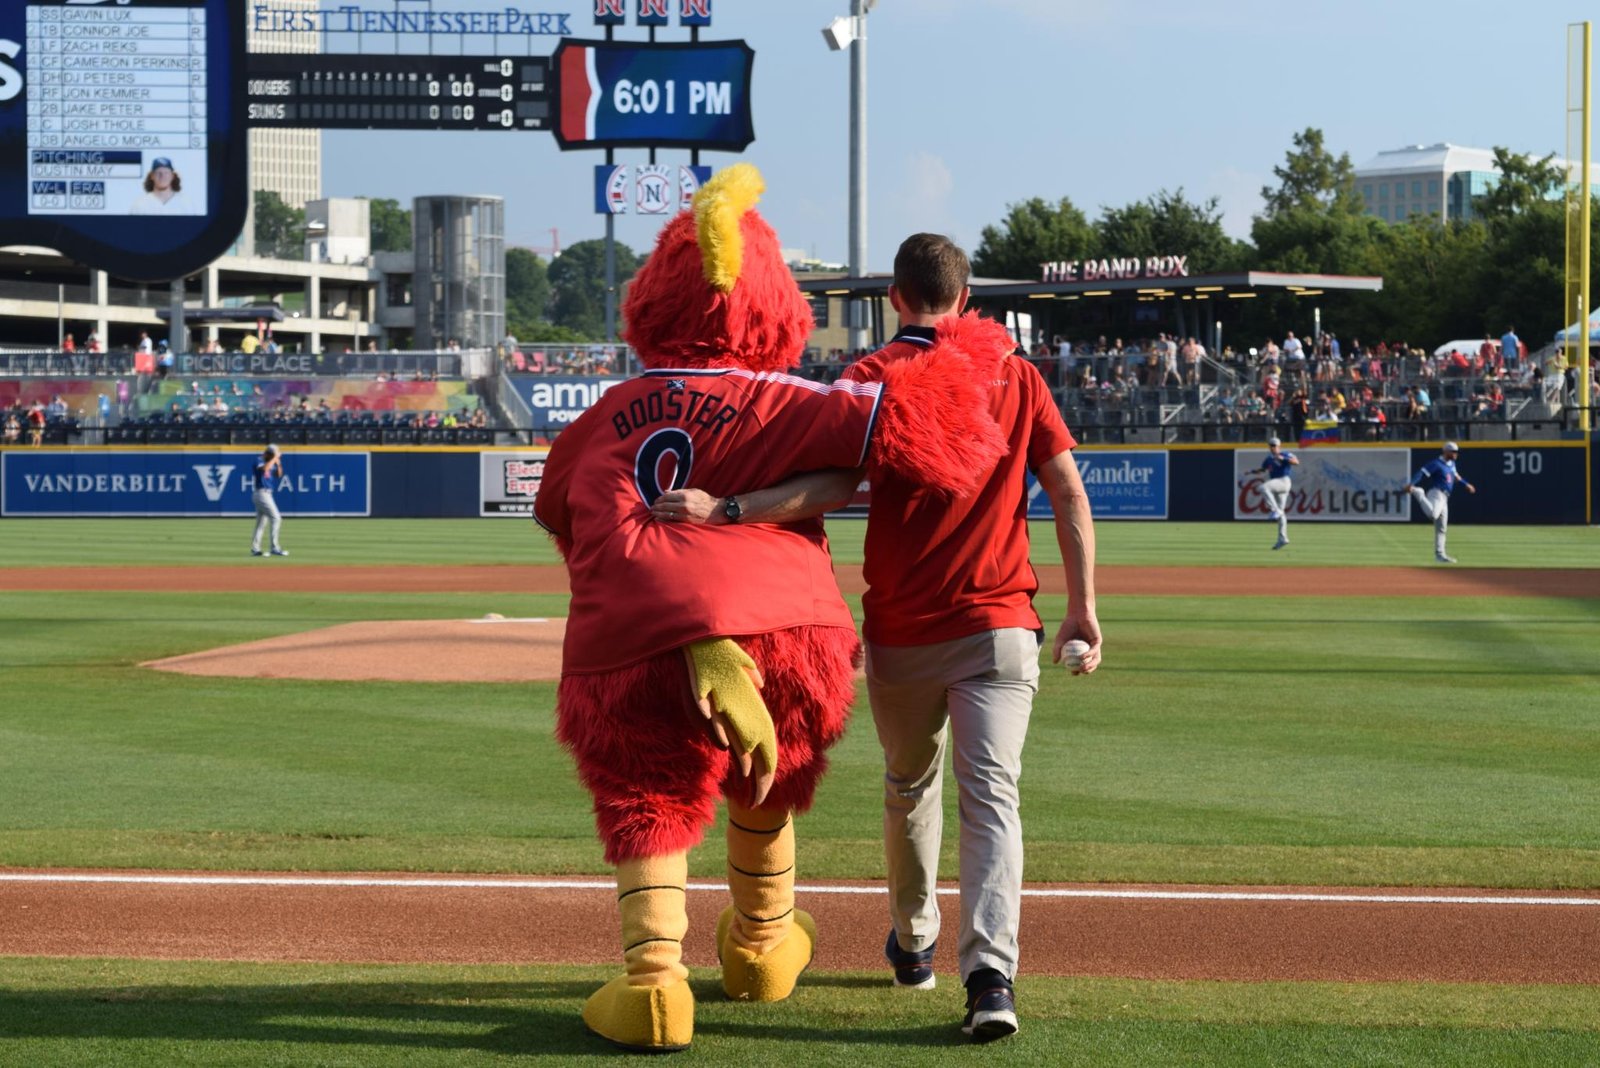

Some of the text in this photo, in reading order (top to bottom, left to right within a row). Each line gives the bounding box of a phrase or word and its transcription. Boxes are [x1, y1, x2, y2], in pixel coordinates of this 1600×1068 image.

[63, 9, 102, 20] GAVIN
[106, 10, 131, 21] LUX
[254, 5, 572, 35] FIRST TENNESSEE PARK
[63, 25, 120, 36] CONNOR
[127, 26, 148, 36] JOE
[63, 41, 99, 51] ZACH
[103, 41, 137, 52] REKS
[41, 56, 59, 67] CF
[63, 57, 128, 68] CAMERON
[133, 57, 187, 69] PERKINS
[501, 59, 513, 77] 0
[63, 72, 79, 83] DJ
[84, 73, 135, 84] PETERS
[63, 88, 90, 98] JON
[94, 89, 150, 99] KEMMER
[429, 81, 440, 97] 0
[451, 81, 462, 97] 0
[463, 81, 474, 97] 0
[501, 84, 513, 102] 0
[613, 79, 732, 115] 6:01 PM
[63, 104, 96, 114] JAKE
[101, 104, 143, 115] PETER
[429, 104, 440, 120] 0
[463, 104, 474, 121] 0
[63, 119, 99, 130] JOSH
[103, 120, 145, 131] THOLE
[501, 109, 513, 127] 0
[64, 135, 118, 146] ANGELO
[122, 136, 161, 146] MORA
[33, 152, 104, 164] PITCHING
[35, 166, 113, 176] DUSTIN MAY
[73, 183, 102, 194] ERA
[1040, 255, 1189, 282] THE BAND BOX
[184, 354, 312, 372] PICNIC PLACE
[611, 390, 738, 440] BOOSTER
[634, 427, 694, 512] 0
[1503, 452, 1542, 475] 310
[1077, 460, 1154, 484] Zander
[24, 474, 186, 493] VANDERBILT
[241, 474, 346, 493] HALTH
[1087, 486, 1154, 497] SURANCE.
[1329, 490, 1405, 514] LIGHT
